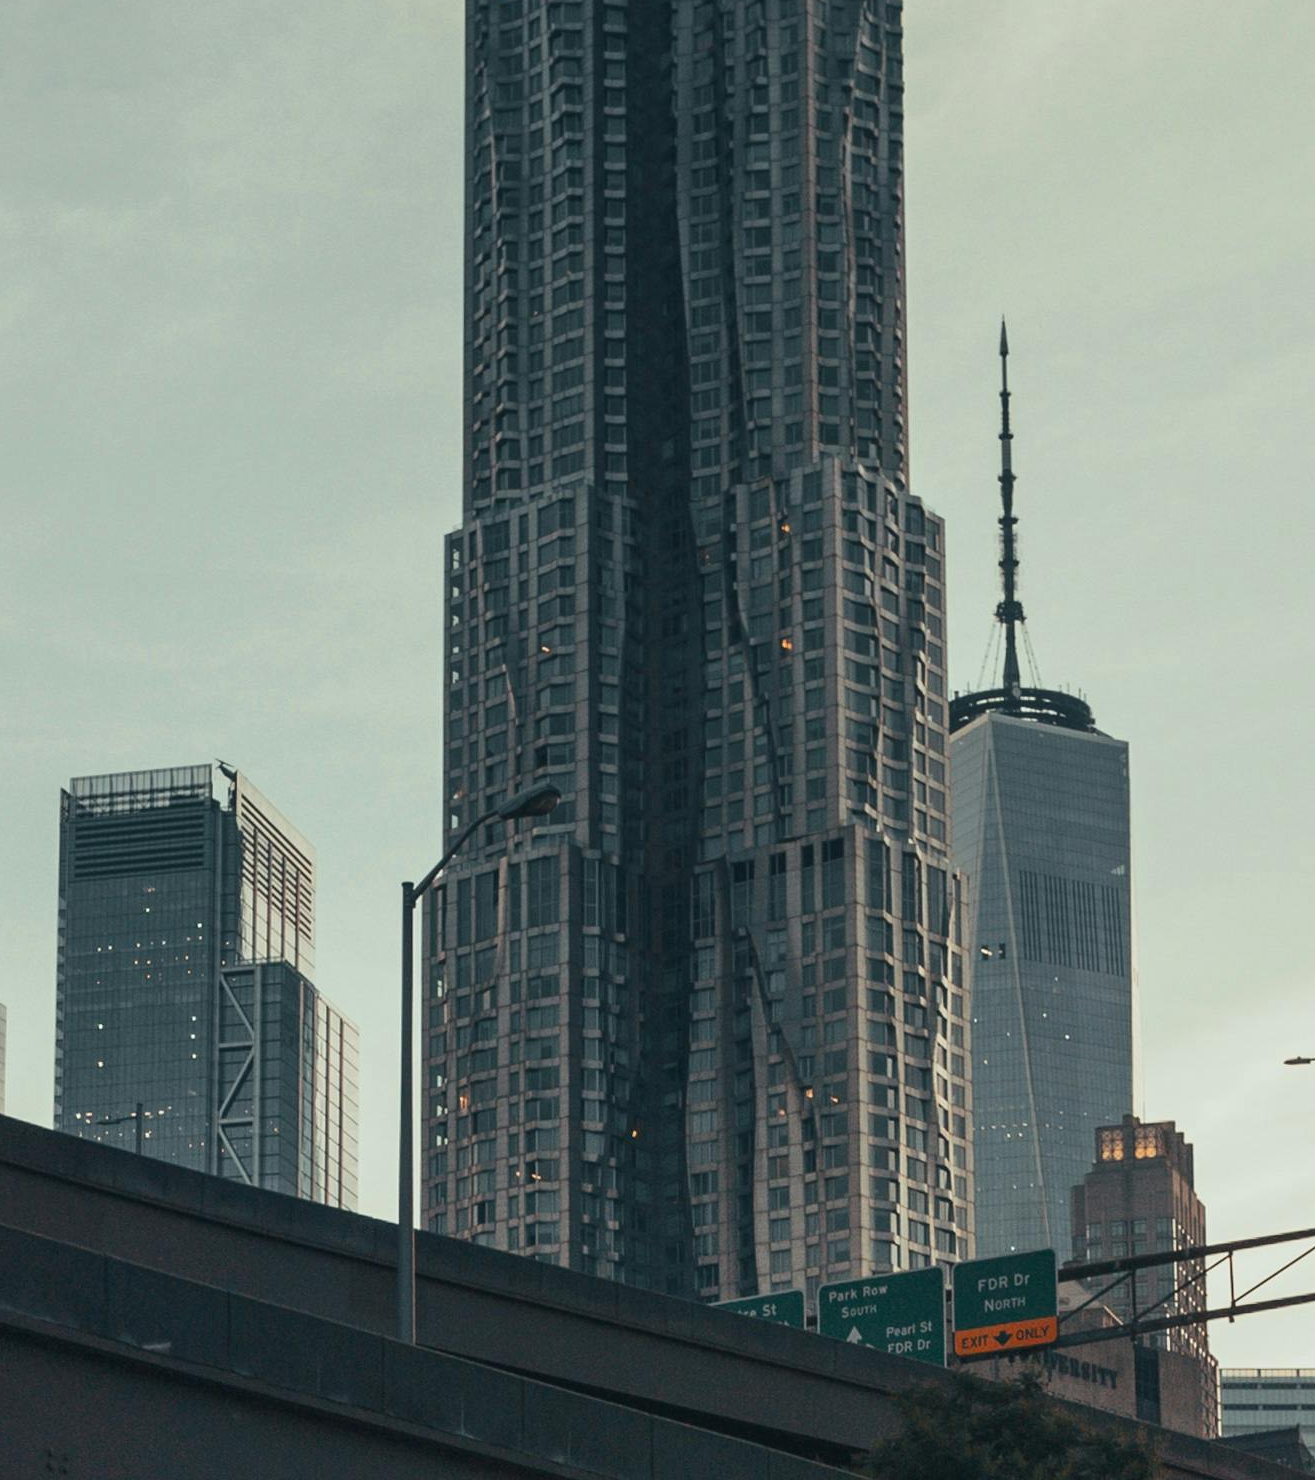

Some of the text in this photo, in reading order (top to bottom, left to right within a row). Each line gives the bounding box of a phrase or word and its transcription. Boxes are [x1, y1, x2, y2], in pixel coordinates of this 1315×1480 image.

[978, 1273, 1030, 1293] FDR Dr
[829, 1284, 888, 1303] Park Row
[762, 1303, 777, 1317] St
[841, 1304, 877, 1319] SOUTH
[985, 1297, 1026, 1312] NORTH
[886, 1320, 933, 1338] Pearl St
[962, 1325, 1050, 1349] EXIT ONLY
[887, 1339, 931, 1354] FDR Dr
